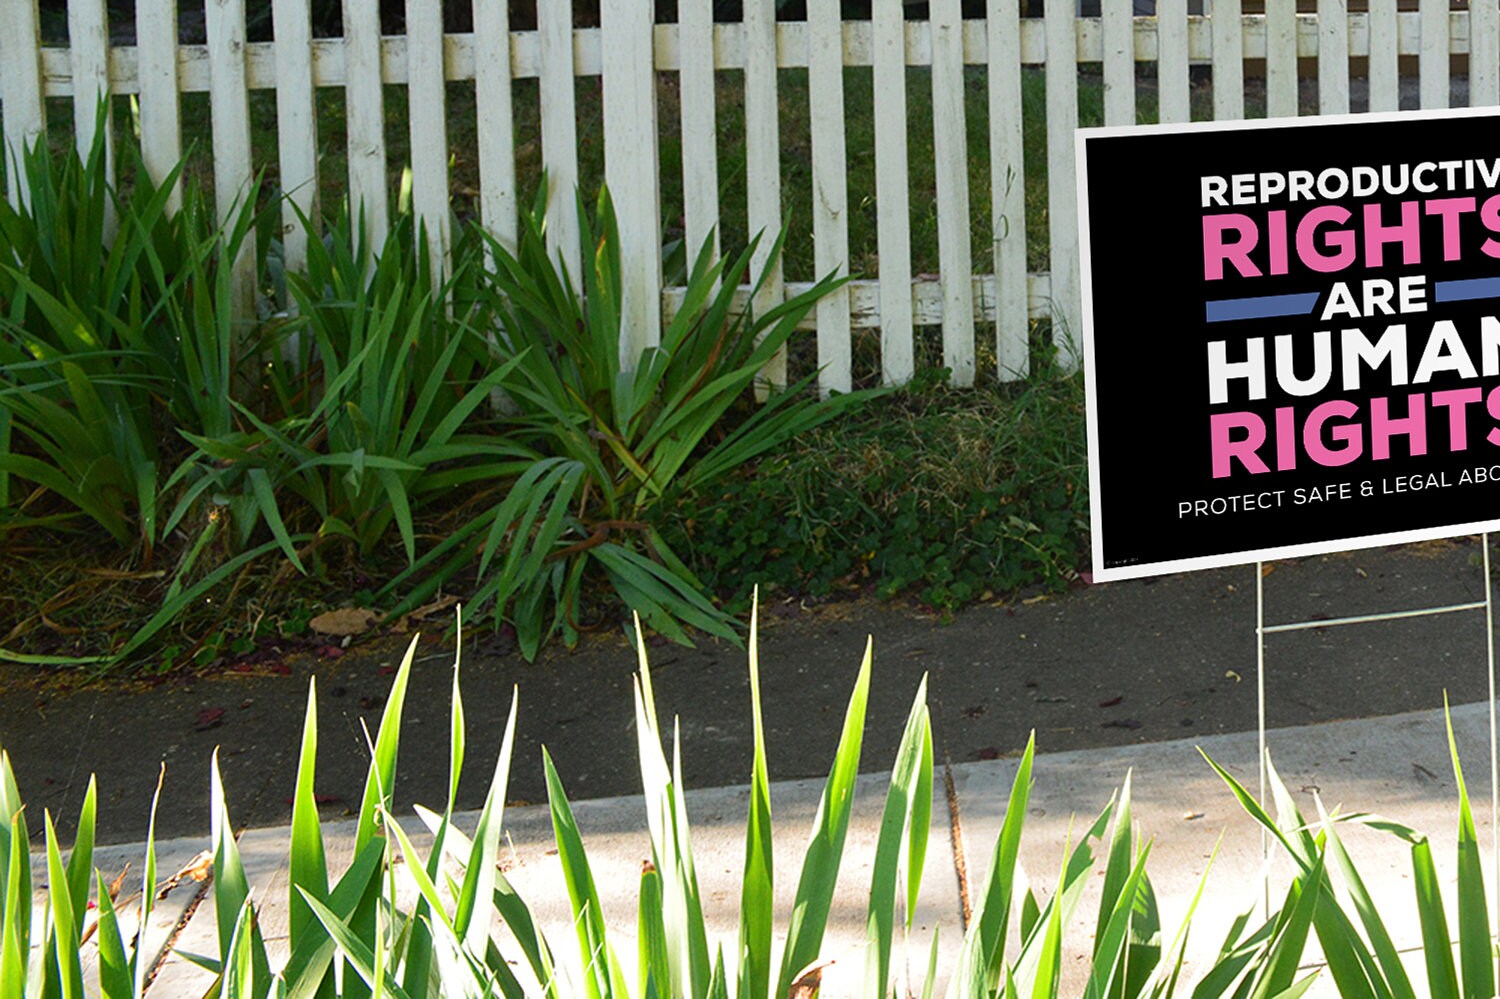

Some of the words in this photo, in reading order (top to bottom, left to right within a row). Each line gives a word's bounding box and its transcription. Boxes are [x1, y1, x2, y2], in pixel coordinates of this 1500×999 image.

[1320, 274, 1428, 321] ARE
[1178, 490, 1286, 519] PROTECT
[1293, 482, 1352, 505] SAFE
[1360, 480, 1374, 497] &
[1382, 472, 1453, 495] LEGAL
